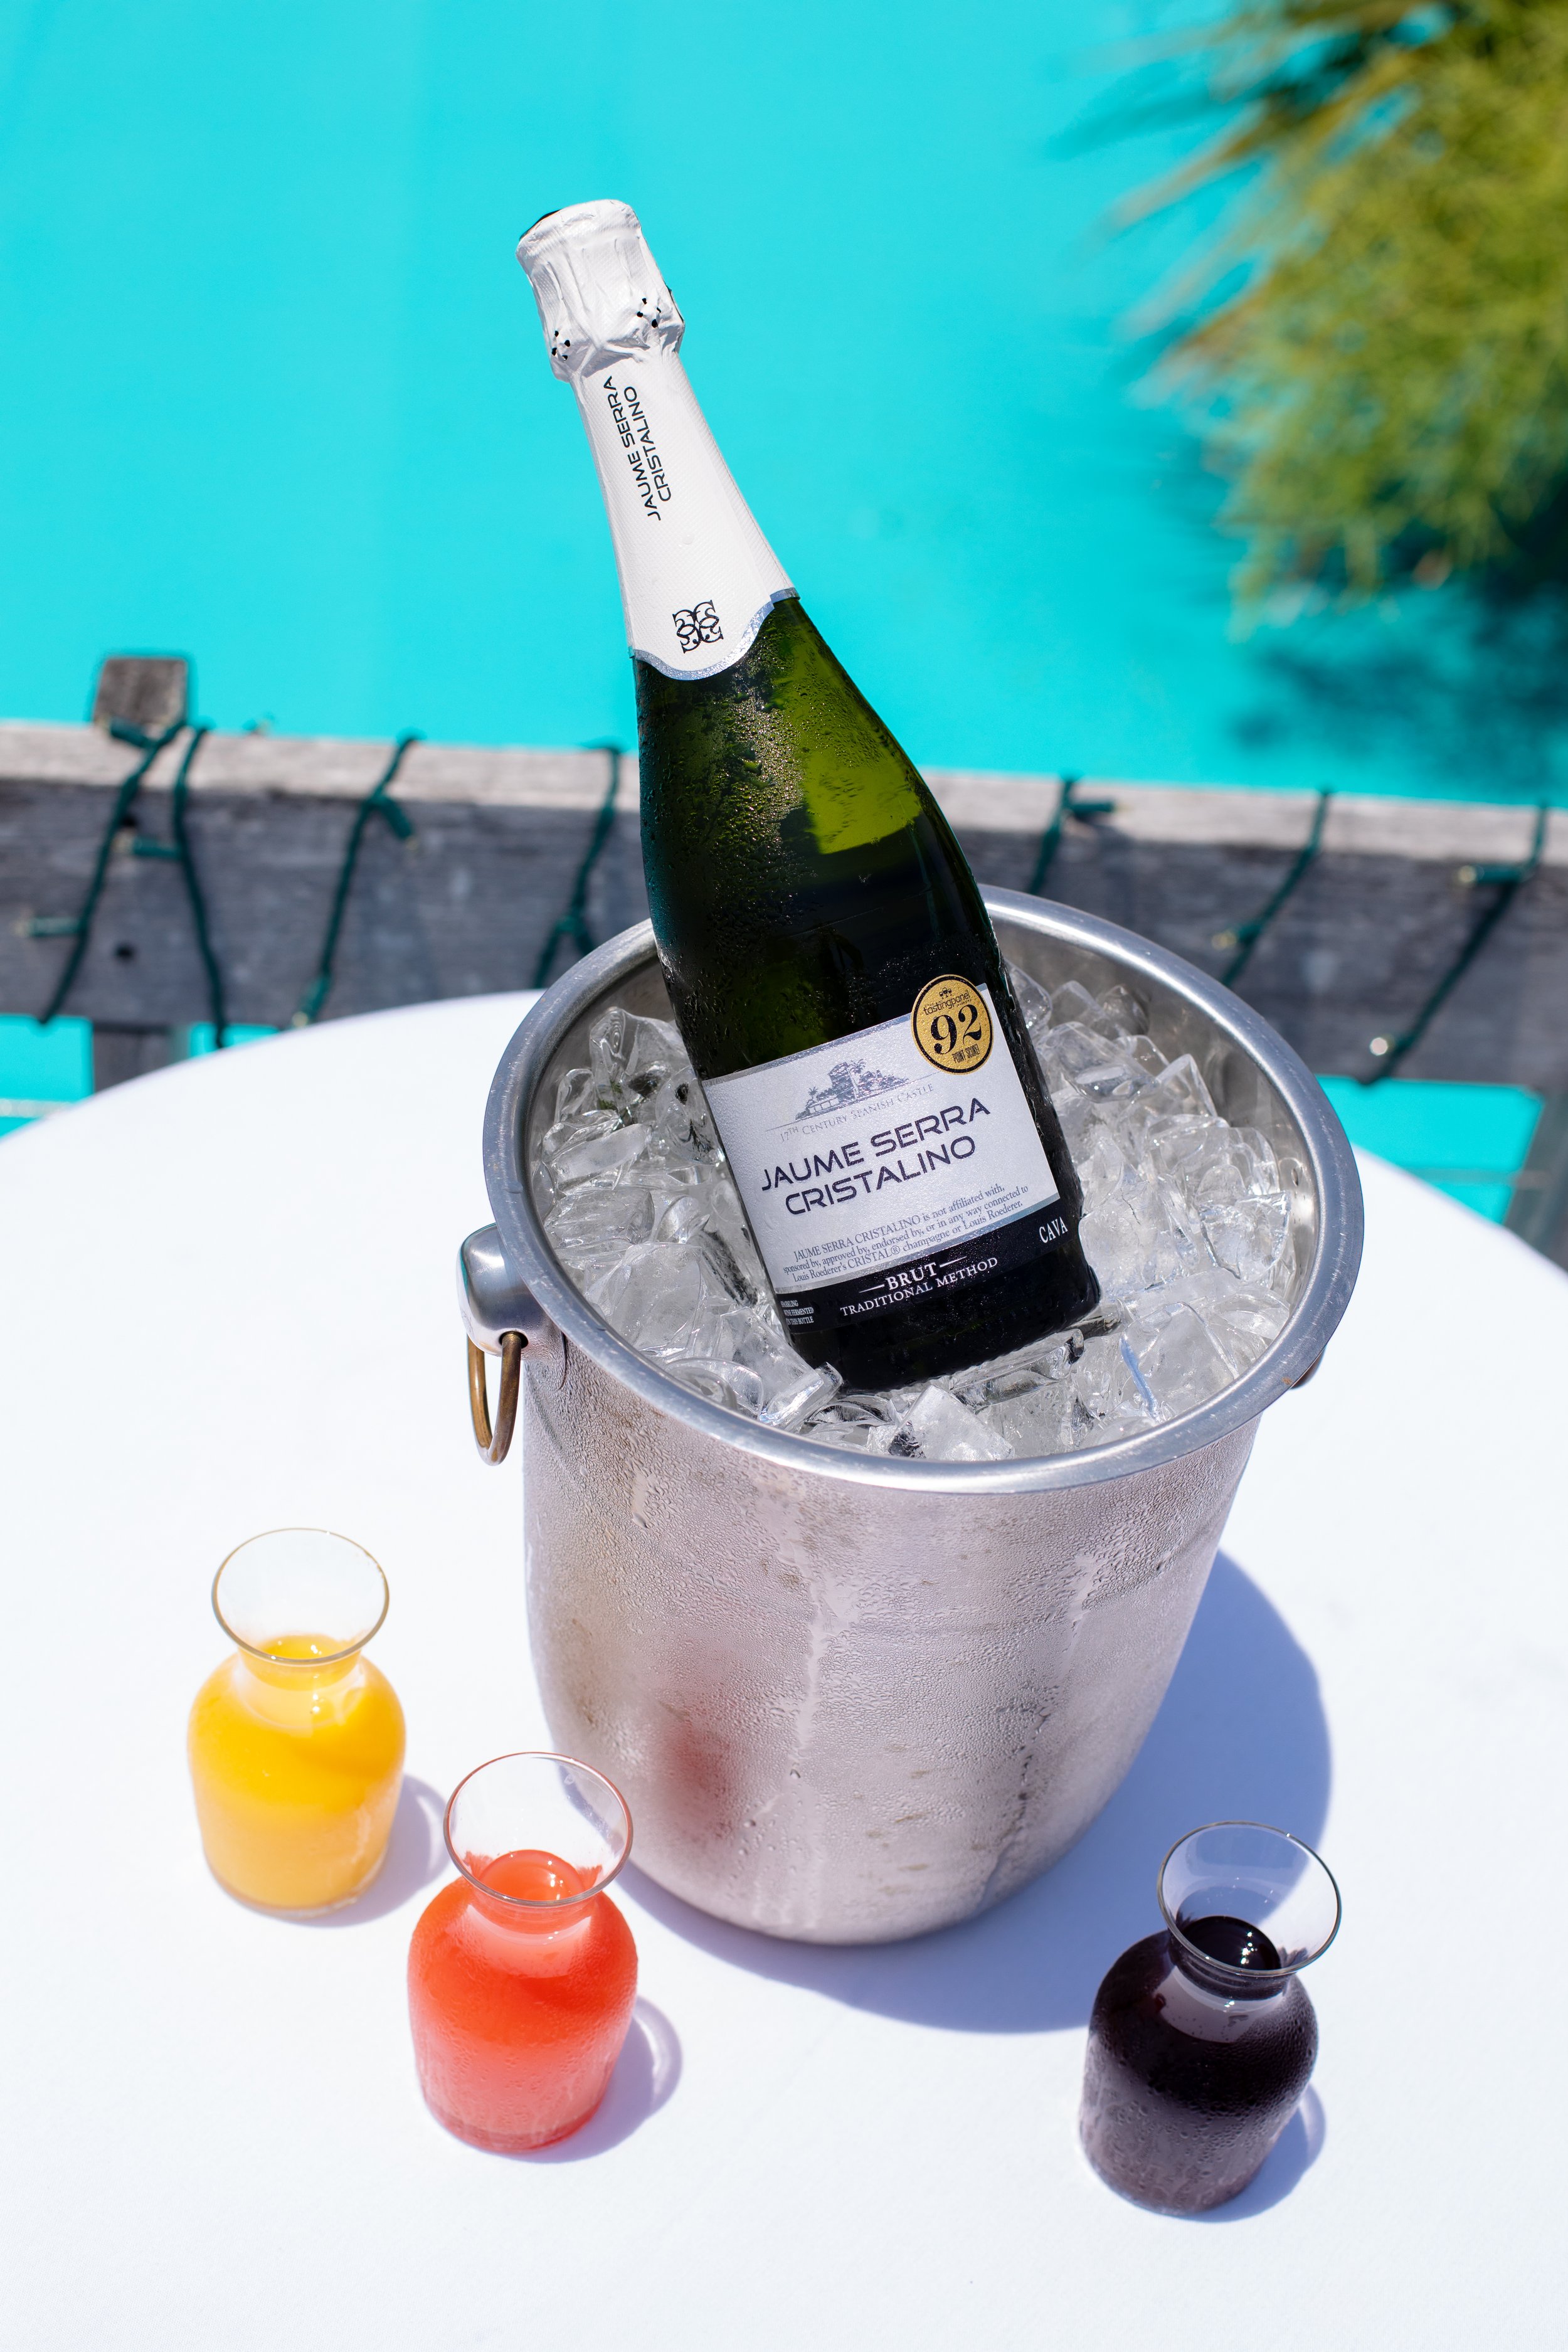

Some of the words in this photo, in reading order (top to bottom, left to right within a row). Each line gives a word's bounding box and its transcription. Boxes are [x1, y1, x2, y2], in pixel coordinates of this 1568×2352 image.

[603, 376, 635, 448] SERRA
[624, 386, 672, 502] CRISTALINO
[627, 451, 661, 521] JAUME
[931, 1004, 982, 1054] 92
[952, 1049, 967, 1063] POINT
[965, 1044, 980, 1059] SCORE!
[761, 1142, 864, 1191] JAUME
[871, 1098, 991, 1157] SERRA
[785, 1135, 975, 1215] CRISTALINO
[783, 1260, 810, 1275] sponsored
[810, 1258, 822, 1268] by,
[822, 1248, 856, 1267] approved
[857, 1243, 871, 1254] by,
[872, 1230, 910, 1250] endorsed
[911, 1226, 924, 1238] by,
[926, 1223, 936, 1232] or
[936, 1219, 947, 1229] in
[948, 1213, 963, 1224] any
[966, 1205, 982, 1217] way
[984, 1185, 1020, 1210] connected
[1020, 1185, 1029, 1194] to
[792, 1270, 810, 1282] Louis
[810, 1262, 847, 1279] Roederer's
[903, 1230, 950, 1252] champagne
[952, 1226, 961, 1234] or
[961, 1215, 987, 1230] Louis
[987, 1200, 1023, 1220] Roederer.
[793, 1246, 822, 1262] JAUME
[822, 1237, 854, 1254] SERRA
[855, 1215, 920, 1244] CRISTALINO
[923, 1212, 931, 1221] is
[933, 1209, 947, 1219] not
[948, 1190, 983, 1213] affiliated
[985, 1183, 1005, 1197] with,
[1039, 1217, 1069, 1244] CAVA
[791, 1306, 814, 1316] FERMENTED
[840, 1283, 933, 1316] TRADITIONAL
[937, 1257, 998, 1288] METHOD
[885, 1262, 938, 1290] BRUT
[798, 1316, 814, 1324] BOTTLE
